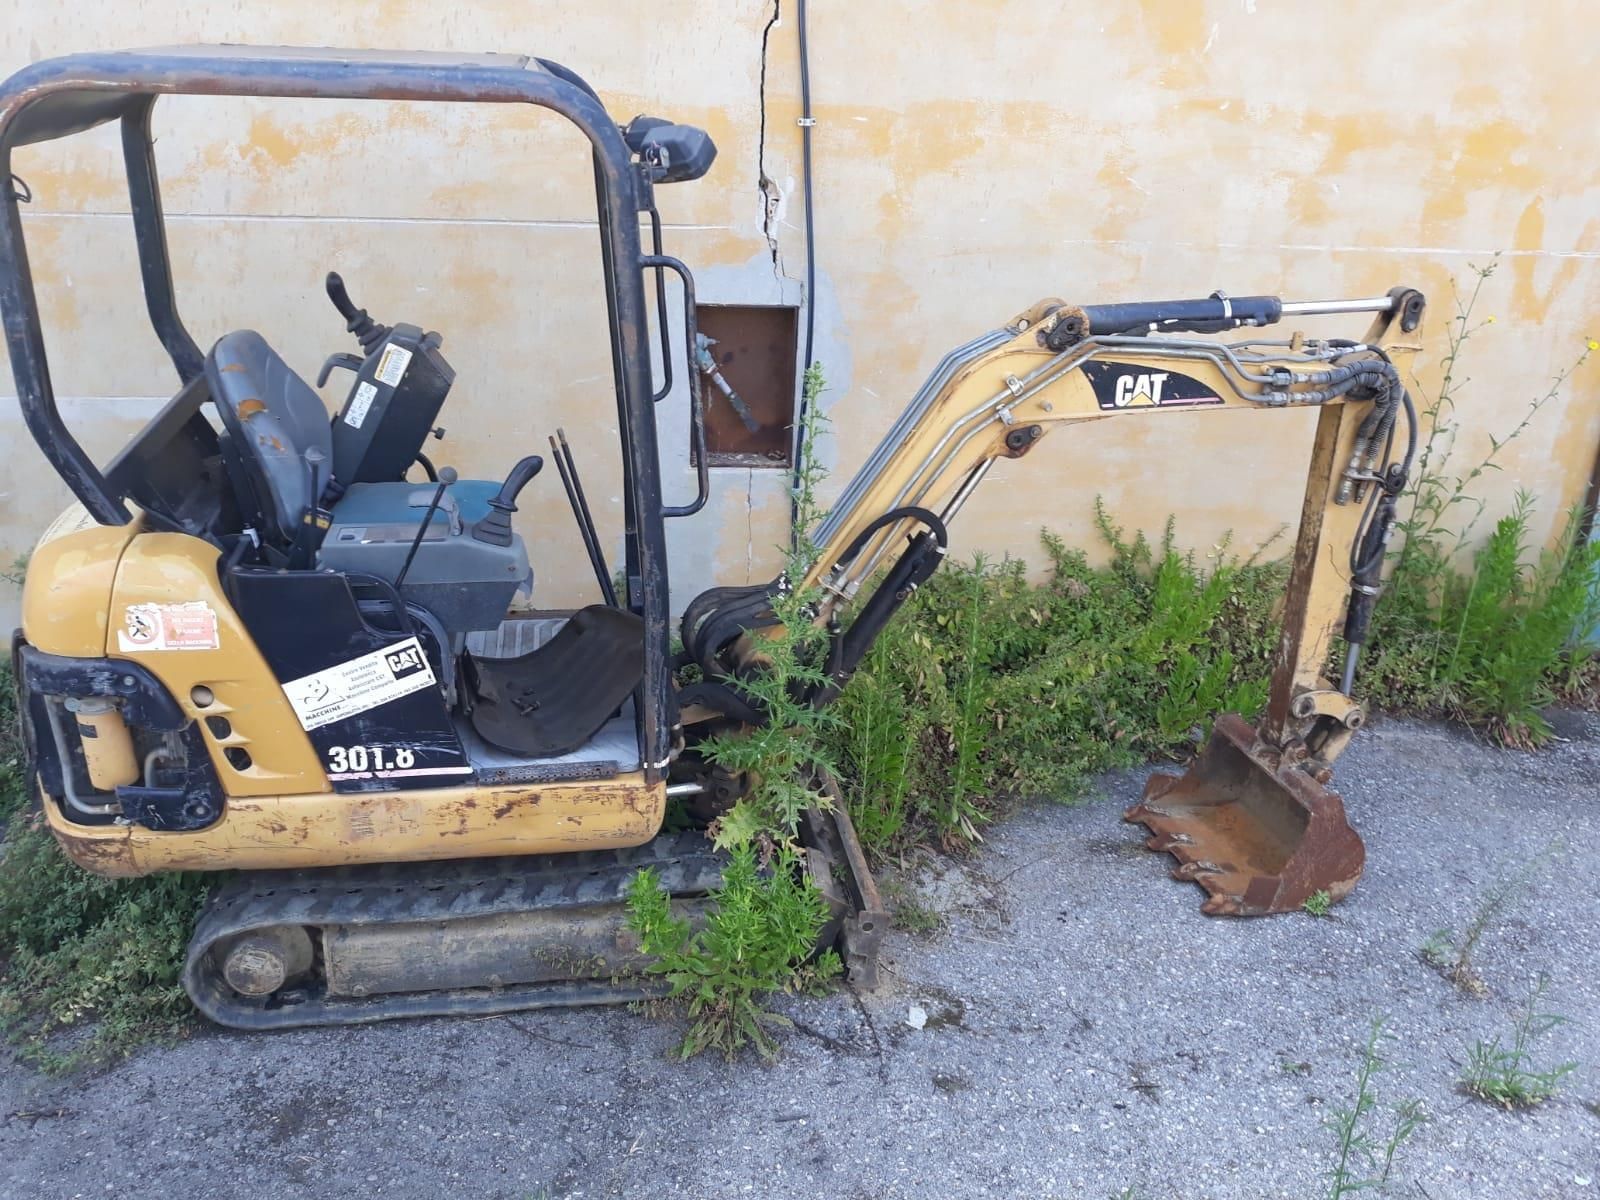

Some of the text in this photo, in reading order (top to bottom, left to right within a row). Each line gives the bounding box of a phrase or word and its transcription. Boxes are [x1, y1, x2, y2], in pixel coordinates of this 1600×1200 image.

[1115, 373, 1169, 407] CAT
[387, 648, 419, 672] CAT
[305, 705, 341, 721] MACCHINE
[328, 745, 415, 773] 301.8
